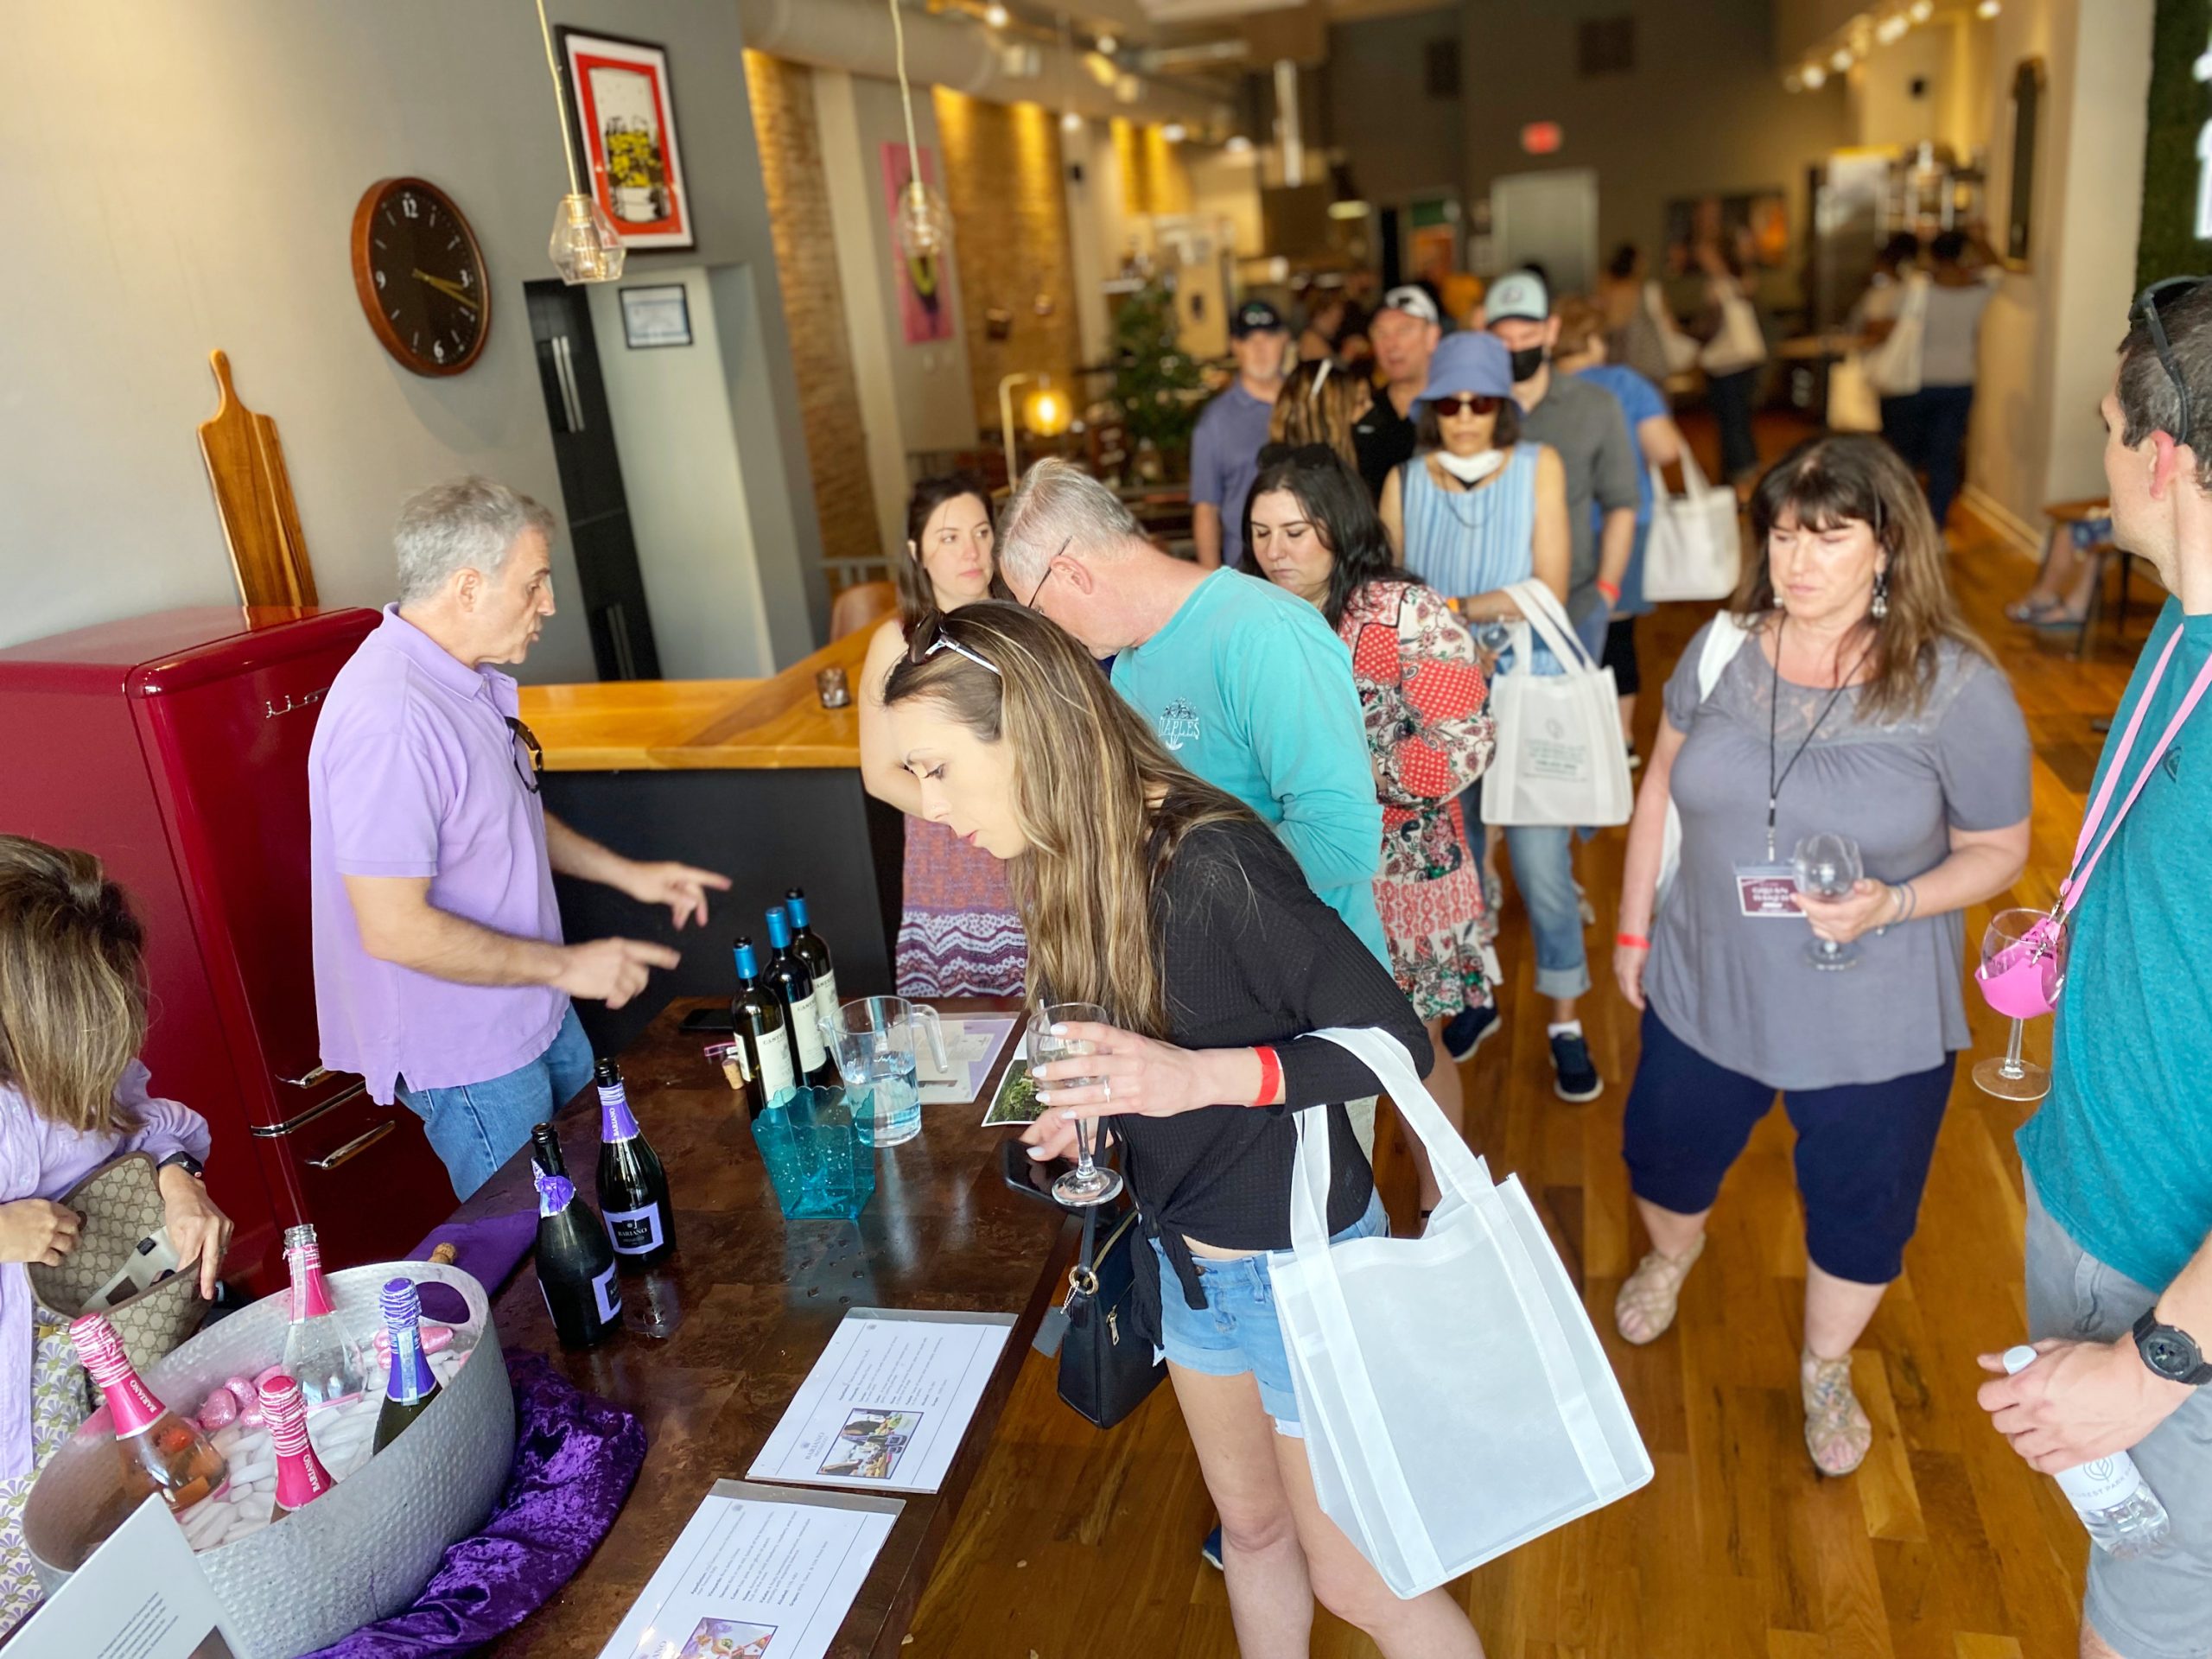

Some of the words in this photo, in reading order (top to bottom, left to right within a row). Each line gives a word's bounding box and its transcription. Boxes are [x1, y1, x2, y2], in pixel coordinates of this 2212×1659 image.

[403, 198, 418, 218] 12
[376, 270, 386, 289] 9
[460, 270, 469, 288] 3
[434, 340, 444, 359] 6
[608, 1108, 619, 1137] BARIANO
[617, 1227, 647, 1236] BARIANO
[130, 1379, 156, 1414] BARIANO
[303, 1454, 321, 1493] BARIANO
